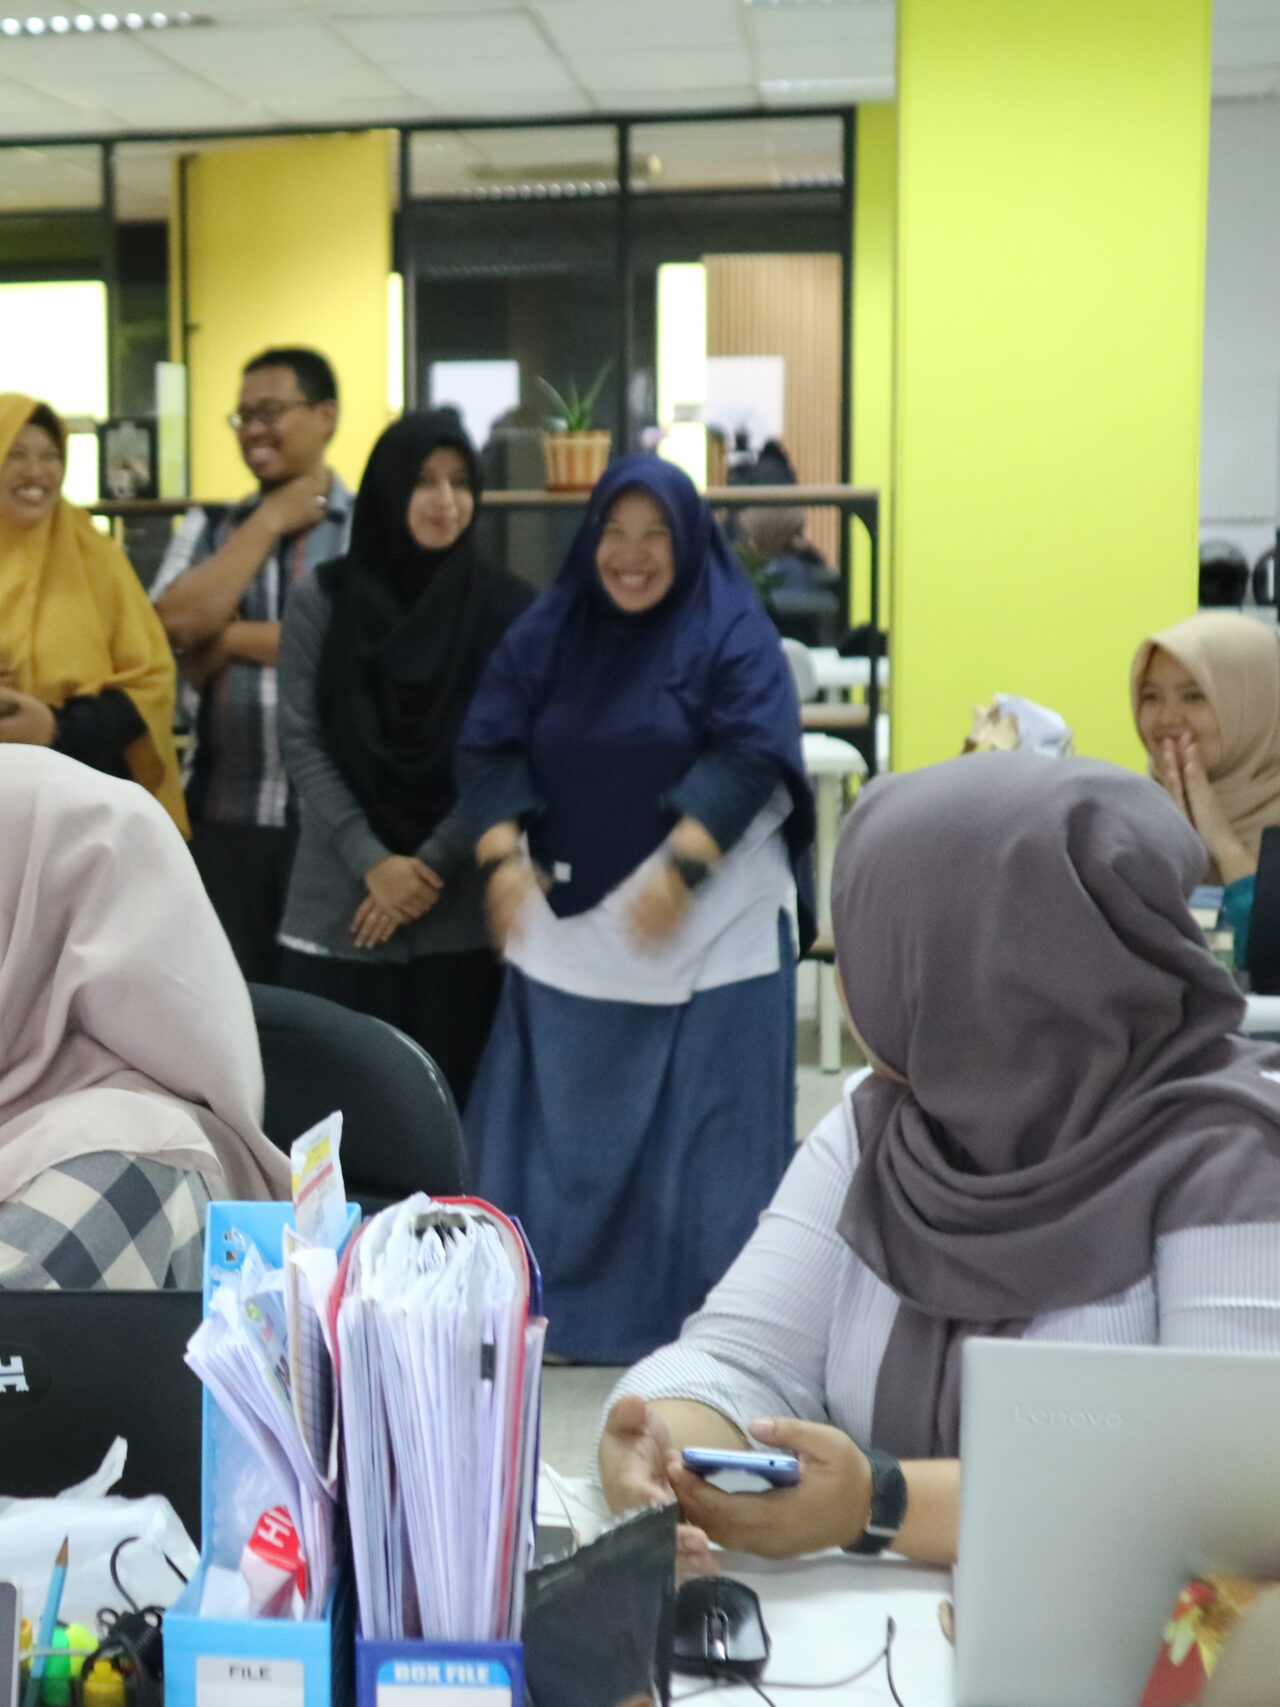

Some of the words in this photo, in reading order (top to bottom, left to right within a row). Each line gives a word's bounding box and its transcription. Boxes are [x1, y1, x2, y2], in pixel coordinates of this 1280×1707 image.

[1014, 1404, 1123, 1427] Lenovo
[228, 1664, 271, 1682] FILE
[394, 1663, 441, 1684] BOX
[446, 1664, 489, 1685] FILE
